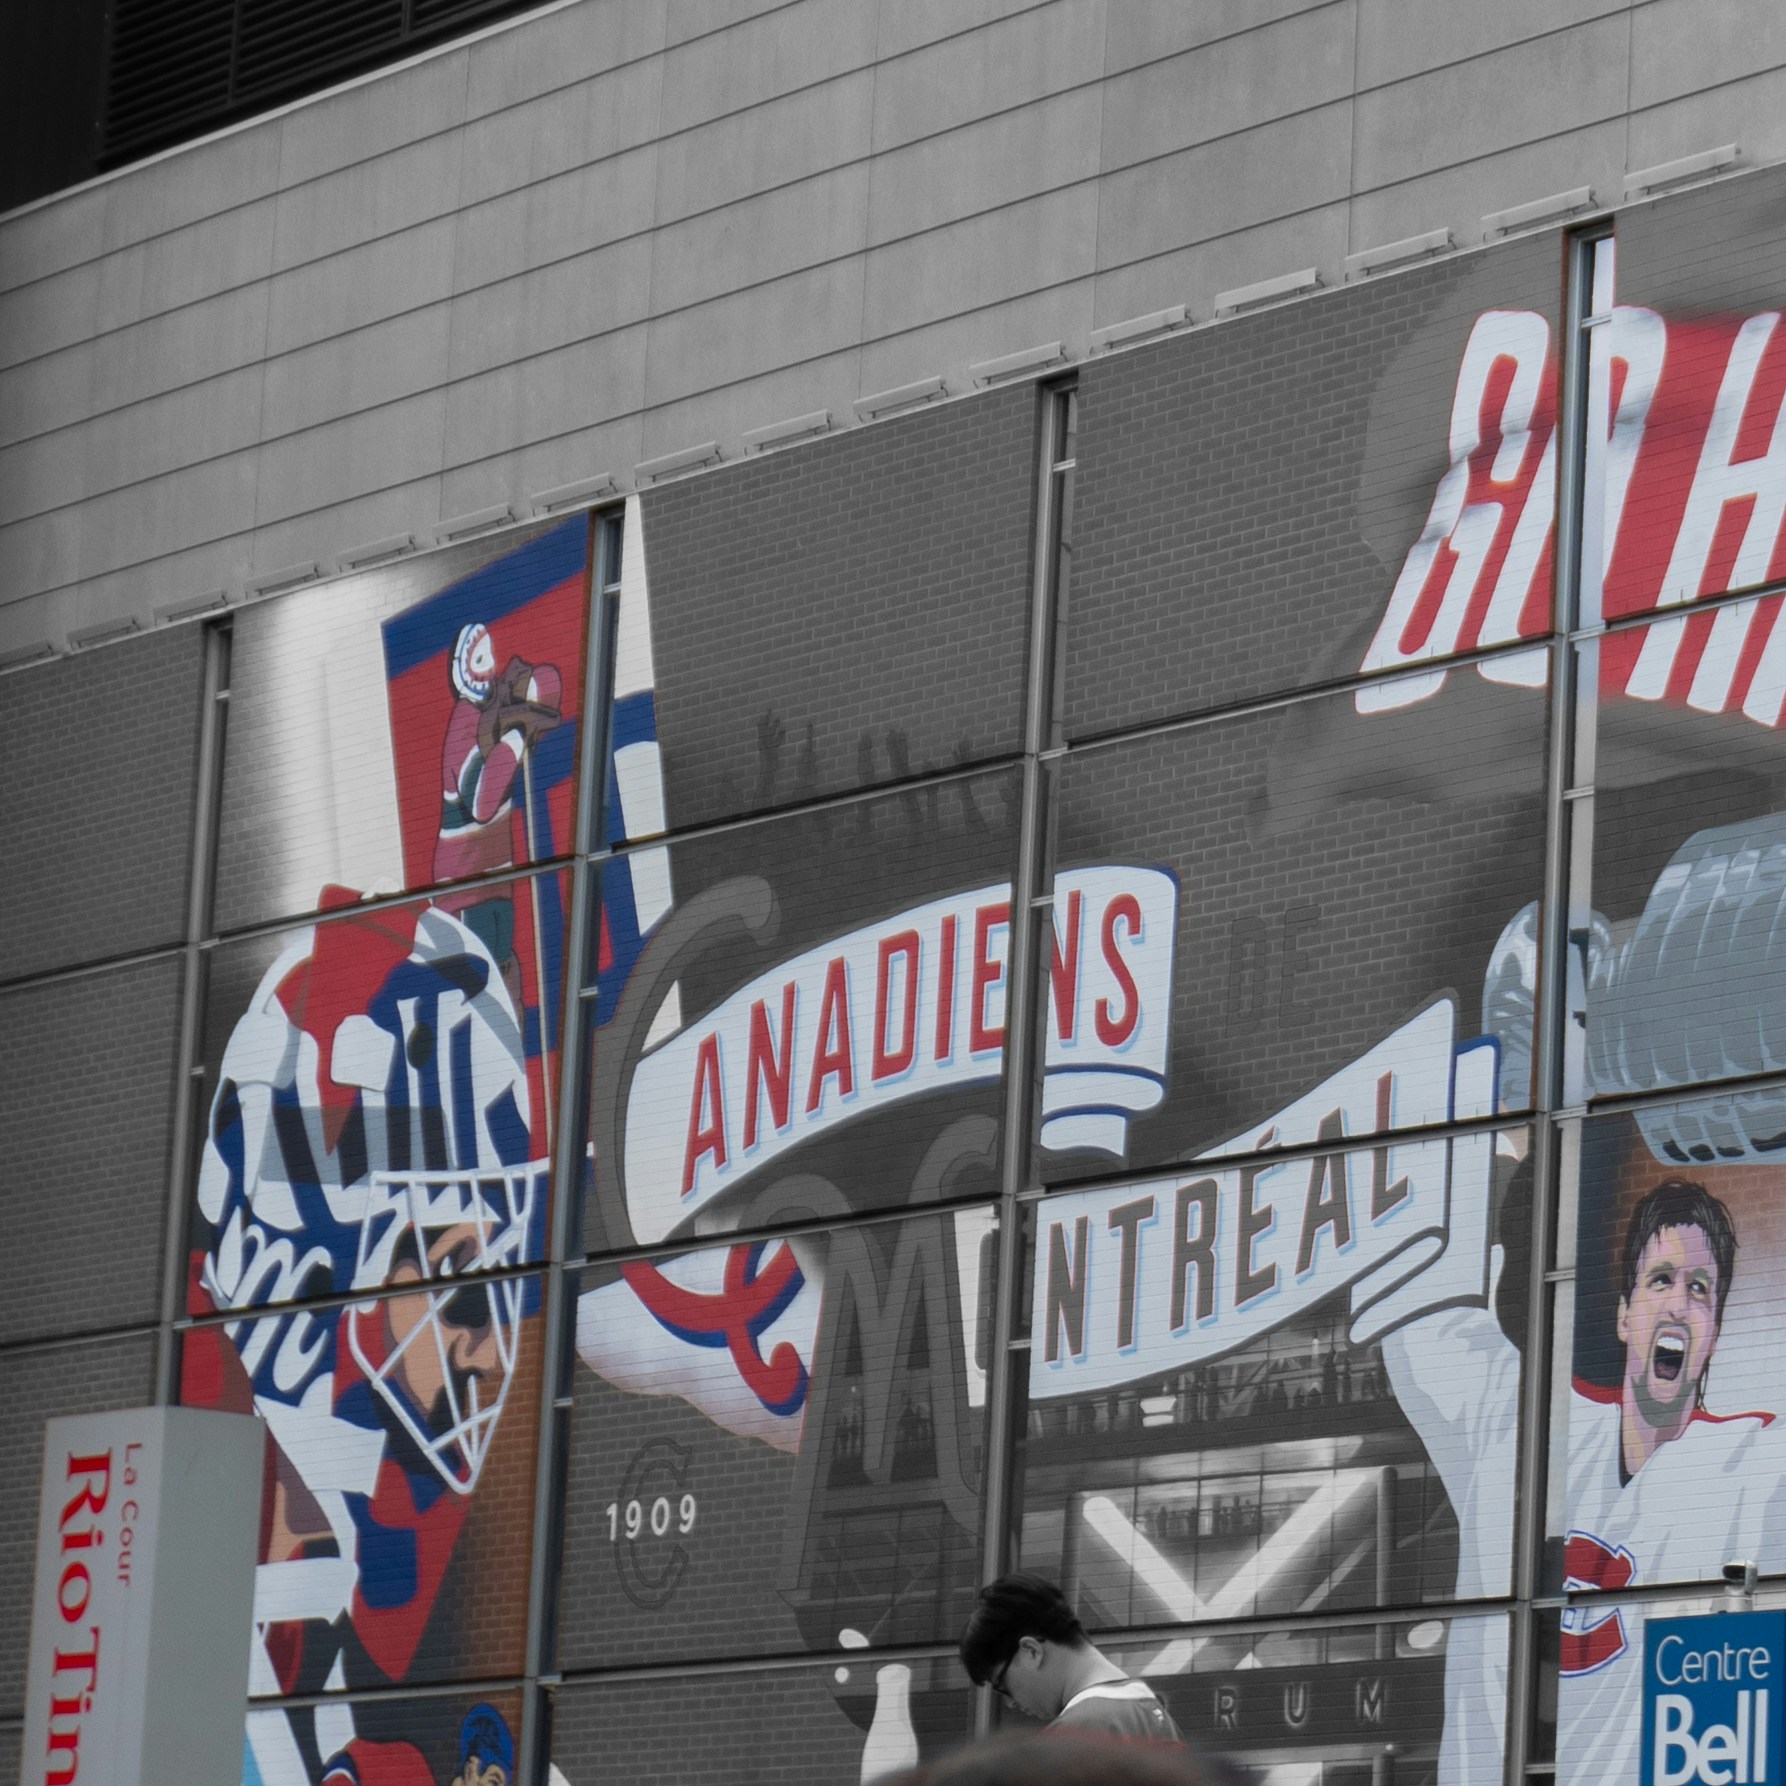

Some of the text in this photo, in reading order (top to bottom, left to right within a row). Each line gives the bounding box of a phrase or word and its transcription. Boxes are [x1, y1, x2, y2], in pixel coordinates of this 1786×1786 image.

[116, 1442, 143, 1588] La Cour
[606, 1493, 696, 1541] 1909
[1656, 1635, 1771, 1686] Centre
